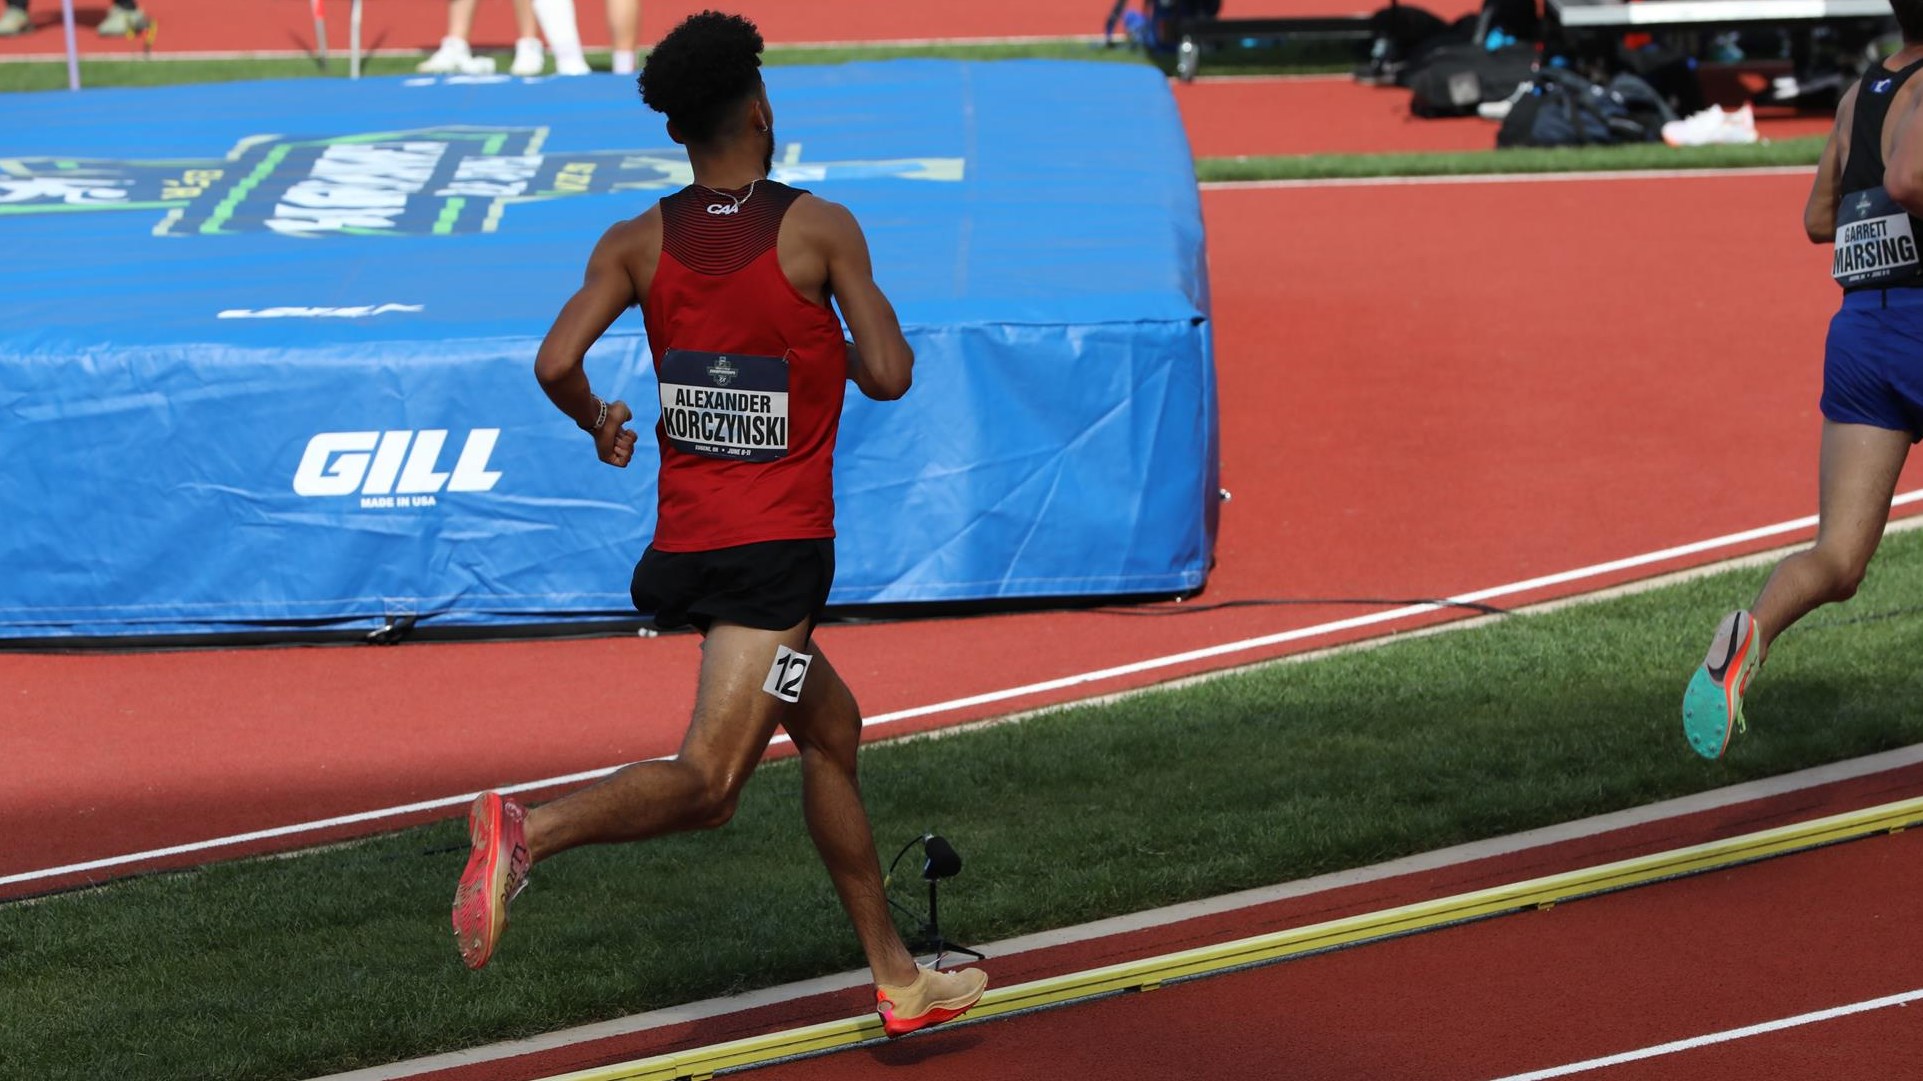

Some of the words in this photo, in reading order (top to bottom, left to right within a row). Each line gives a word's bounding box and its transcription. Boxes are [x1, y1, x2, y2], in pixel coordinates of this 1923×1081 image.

[1844, 220, 1887, 243] GARRETT
[1833, 235, 1916, 275] MARSING
[675, 388, 771, 413] ALEXANDER
[664, 407, 786, 446] KORCZYNSKI
[293, 428, 503, 497] GILL
[360, 497, 395, 509] MADE
[397, 497, 410, 508] IN
[412, 496, 436, 507] USA
[774, 653, 807, 698] 12
